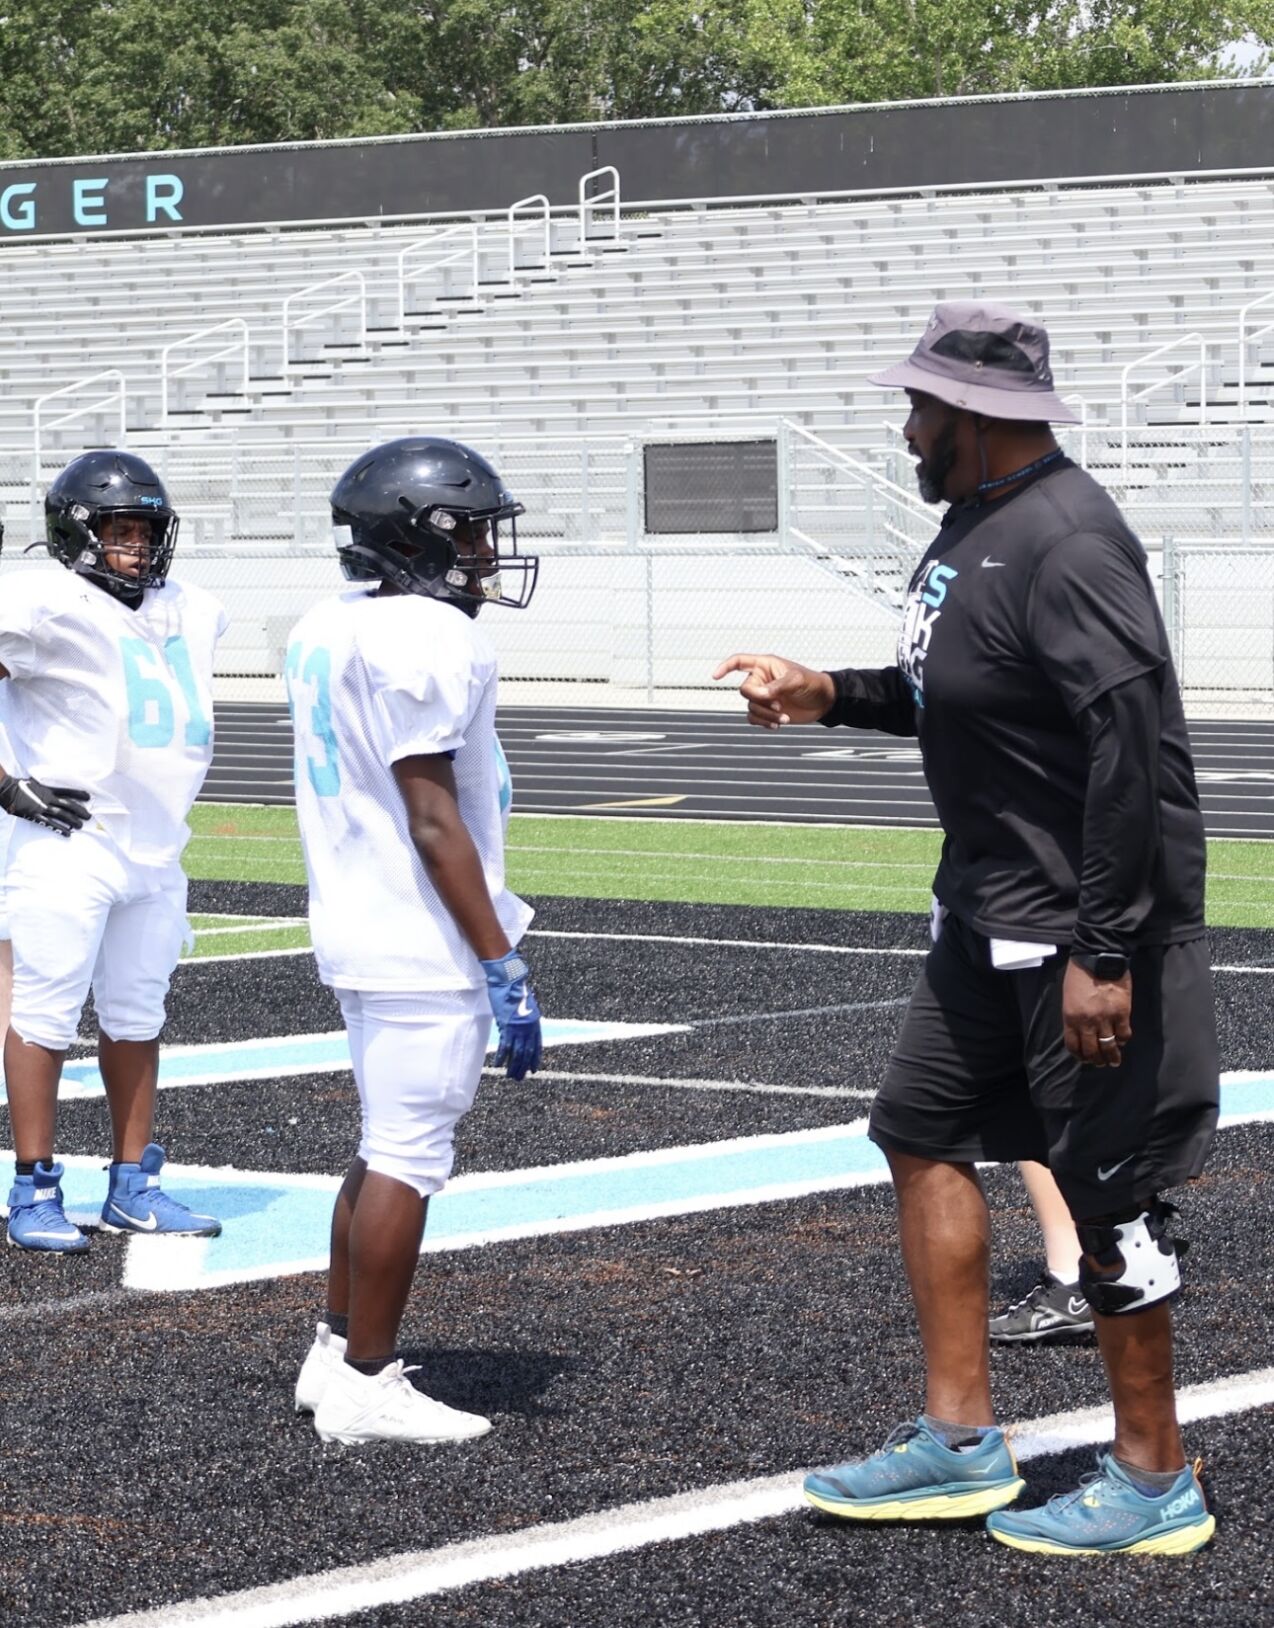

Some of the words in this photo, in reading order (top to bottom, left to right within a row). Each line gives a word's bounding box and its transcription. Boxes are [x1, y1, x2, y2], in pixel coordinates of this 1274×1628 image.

[0, 174, 184, 230] GER
[118, 634, 210, 748] 61
[34, 1187, 57, 1200] NIKE
[1159, 1488, 1200, 1523] HOKA
